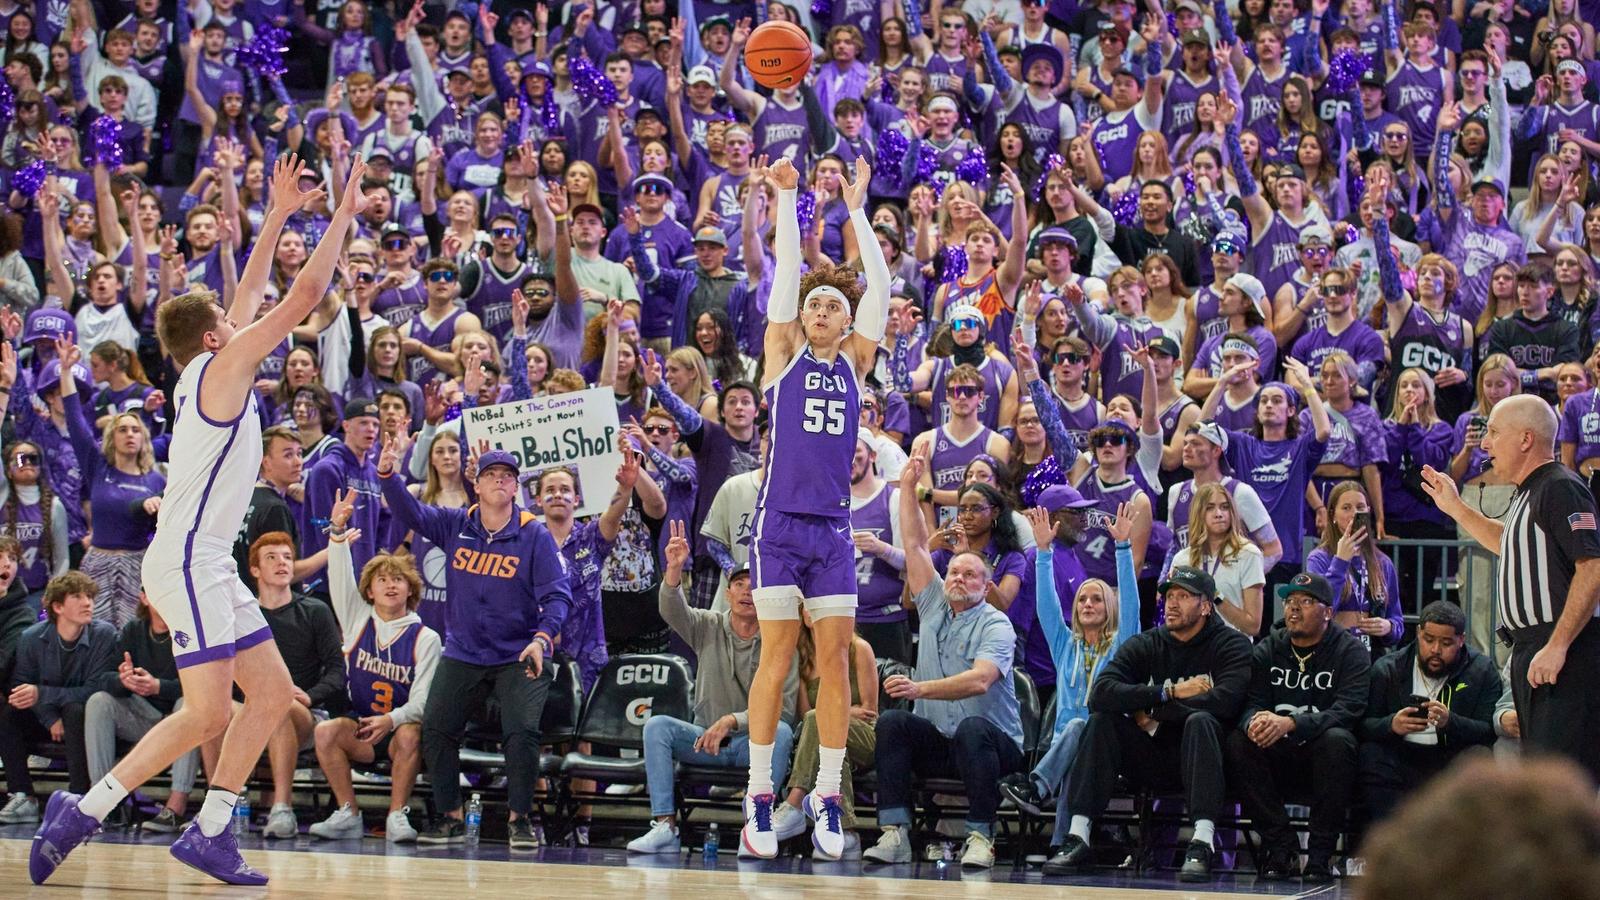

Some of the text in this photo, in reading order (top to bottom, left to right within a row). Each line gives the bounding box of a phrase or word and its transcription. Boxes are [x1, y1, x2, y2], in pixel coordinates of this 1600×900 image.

[1418, 105, 1432, 122] 4
[1096, 123, 1128, 144] GCU
[34, 316, 66, 332] GCU
[1510, 345, 1555, 366] GCU
[805, 372, 848, 394] GCU
[470, 407, 505, 423] NoBad
[548, 396, 584, 409] Canyon
[537, 415, 552, 424] out
[802, 397, 847, 436] 55
[495, 425, 614, 469] oBad.ShoP
[21, 547, 38, 569] 4
[1085, 536, 1109, 559] 4
[452, 547, 520, 579] SUNS
[355, 647, 412, 685] PHOENIX
[616, 663, 671, 686] GCU
[370, 680, 394, 714] 3
